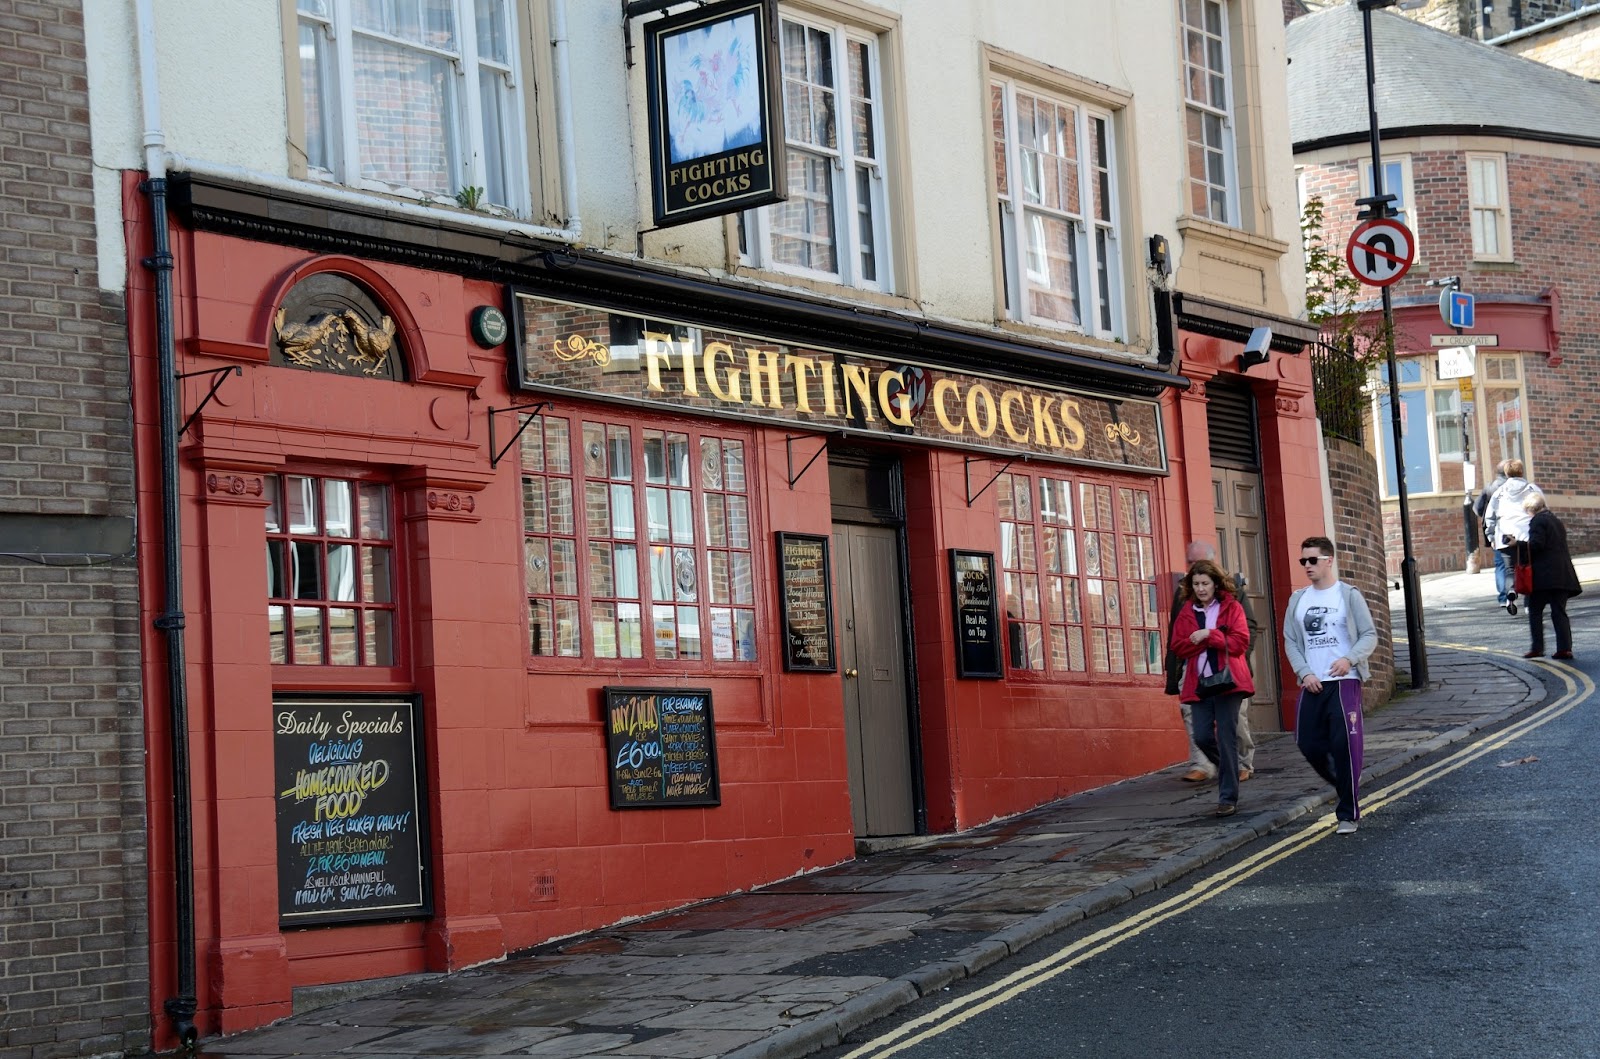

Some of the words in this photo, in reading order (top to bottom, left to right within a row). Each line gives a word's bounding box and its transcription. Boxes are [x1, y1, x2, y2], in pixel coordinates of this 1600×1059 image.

[670, 150, 764, 186] FIGHTING
[685, 174, 751, 203] COCKS
[1449, 337, 1489, 345] CROSSGATE
[642, 330, 914, 427] FIGHTING
[933, 378, 1085, 450] COCKS
[785, 546, 821, 559] FIGHTING
[791, 557, 817, 568] COCKS
[963, 571, 984, 580] COCKS
[791, 600, 808, 609] Served
[965, 615, 978, 625] Real
[978, 616, 987, 625] Ale
[968, 628, 975, 637] on
[976, 627, 986, 638] Tap
[611, 704, 629, 734] ANY
[629, 696, 638, 737] 2
[661, 696, 677, 714] FOR
[277, 711, 332, 740] Daily
[336, 711, 403, 740] Specials
[309, 738, 363, 765] DELICIOUS
[281, 759, 389, 800] HOMECOOKED
[315, 791, 363, 821] FOOD
[291, 821, 323, 844] FRESH
[345, 816, 375, 835] COOKED
[377, 811, 410, 832] DAILY!
[300, 843, 311, 857] ALL
[306, 856, 318, 877] 2
[318, 854, 334, 873] FOR
